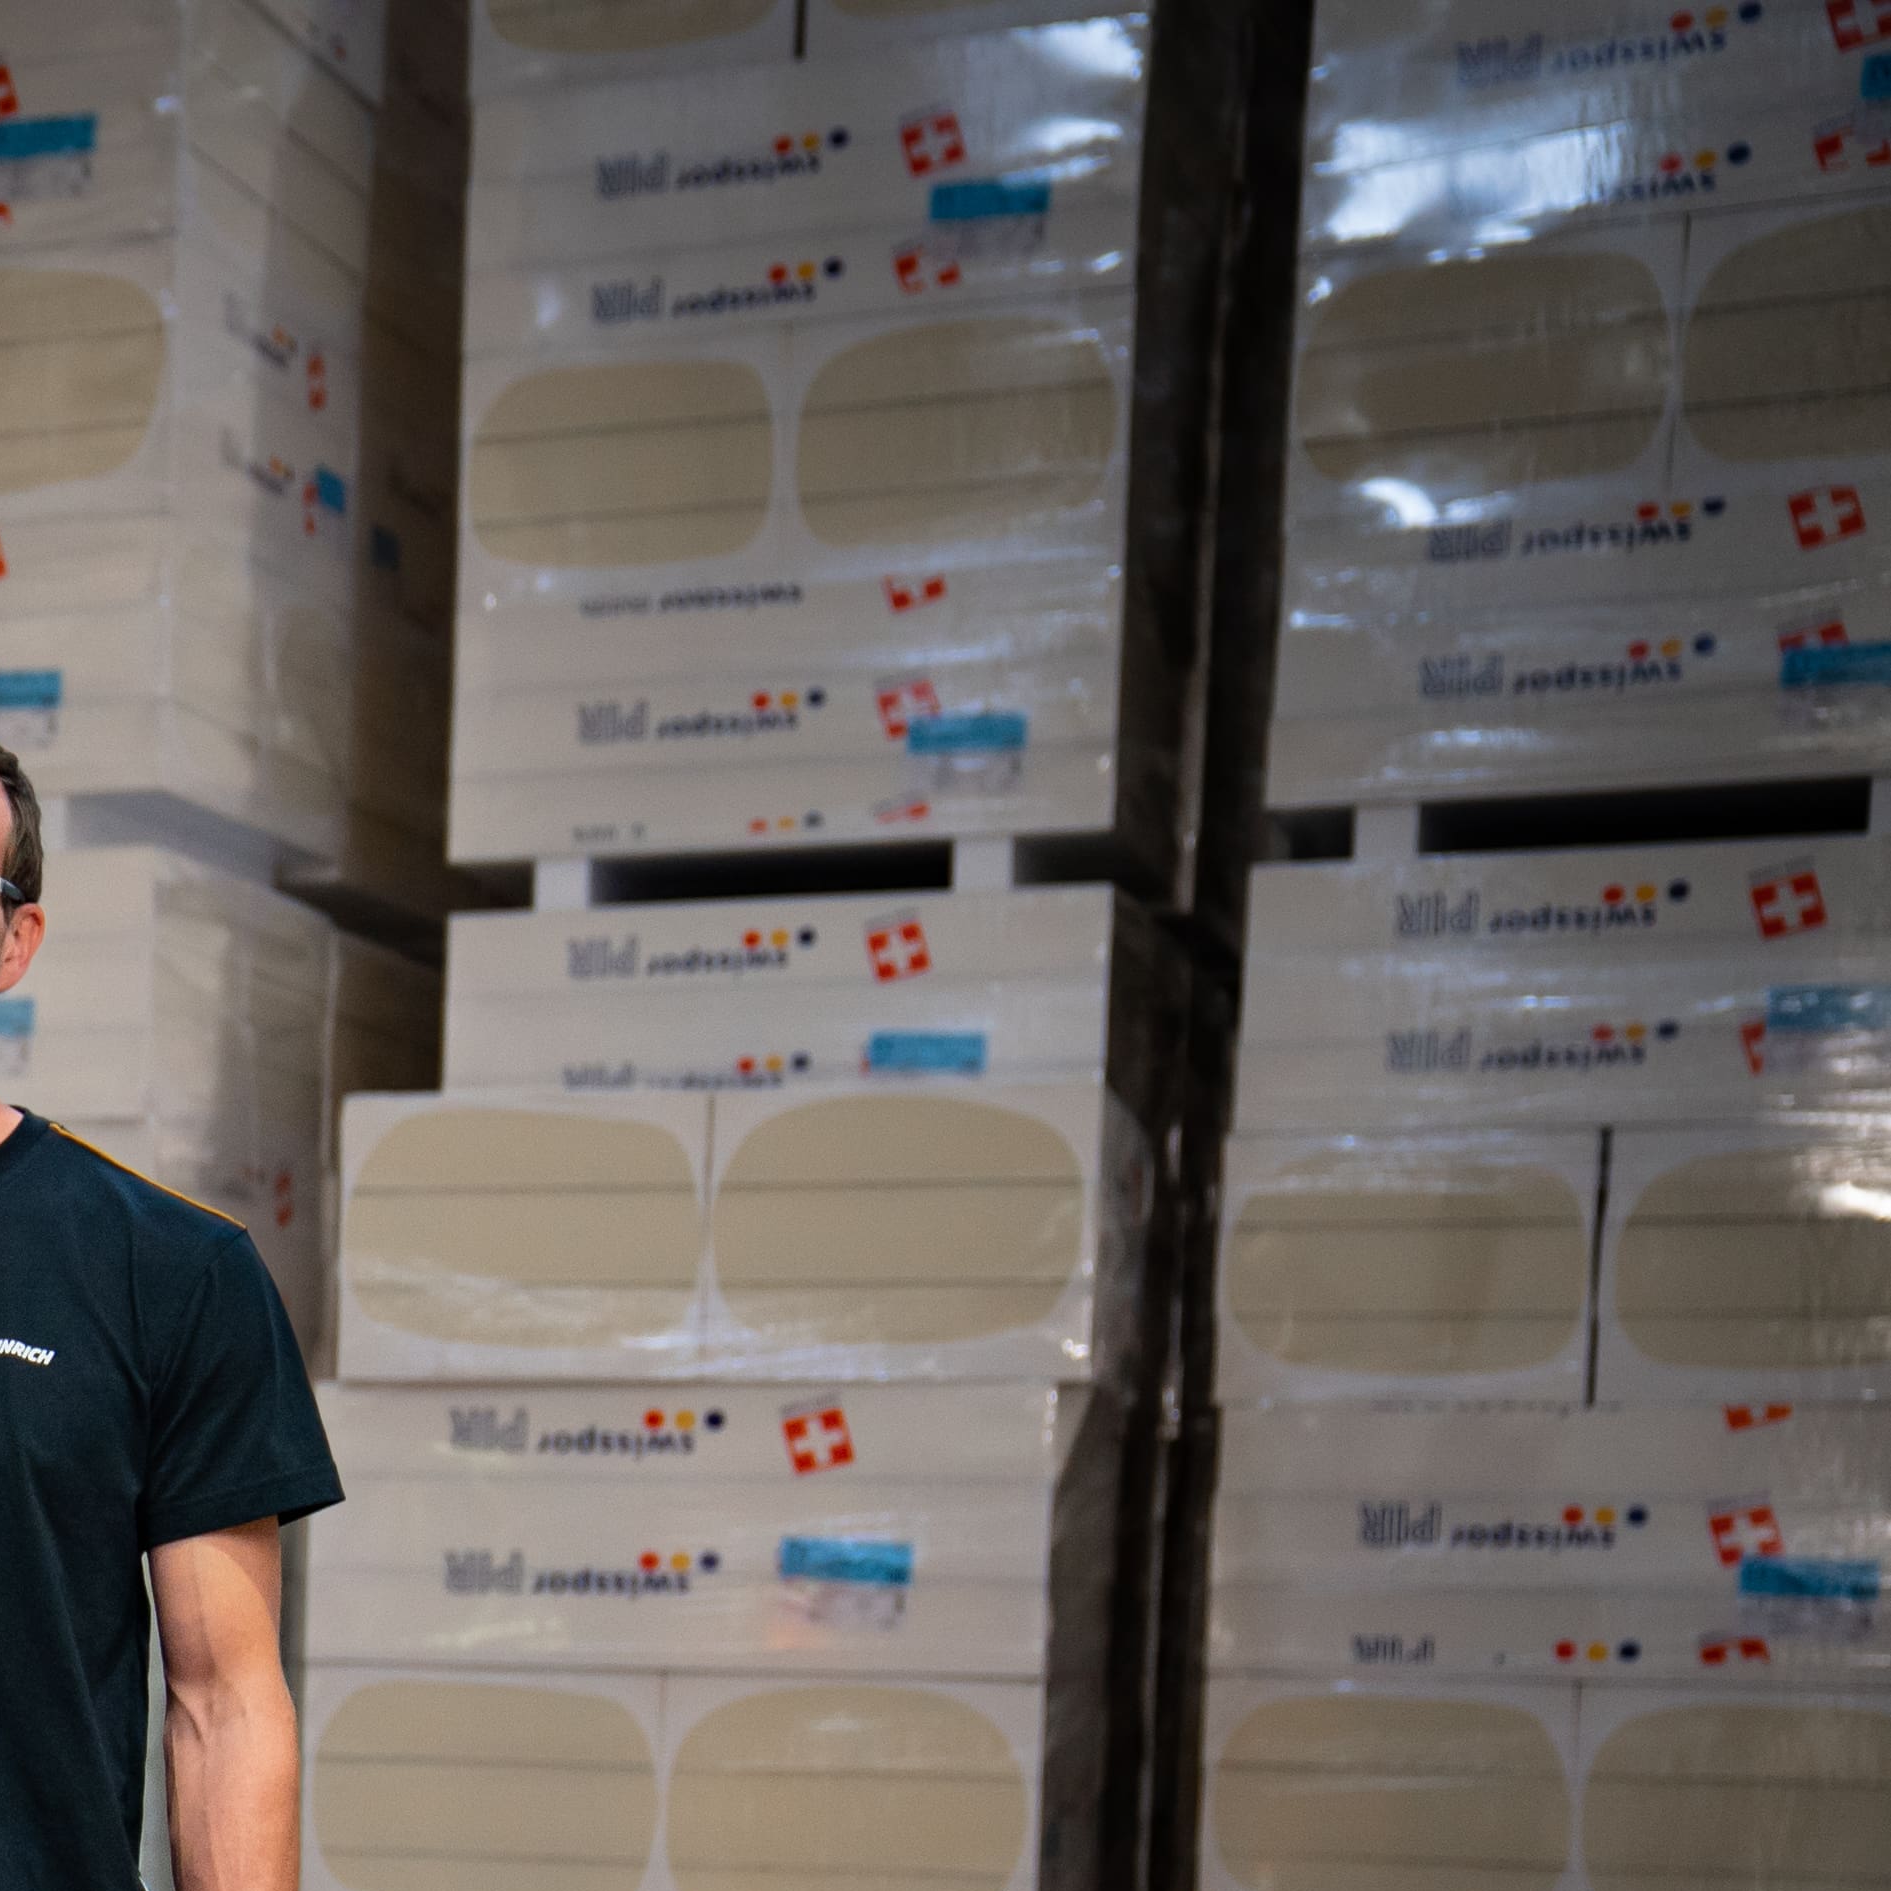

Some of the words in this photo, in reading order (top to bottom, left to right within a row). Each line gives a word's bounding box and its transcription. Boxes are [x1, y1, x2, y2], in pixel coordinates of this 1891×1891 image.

[1554, 30, 1727, 71] swisspor
[1521, 522, 1692, 553] swisspor
[1513, 662, 1681, 694] swisspor
[1395, 891, 1479, 938] PIR
[1489, 905, 1657, 935] swisspor
[1480, 1042, 1646, 1072] swisspor
[1358, 1500, 1441, 1550] PIR
[1450, 1521, 1615, 1554] swisspor
